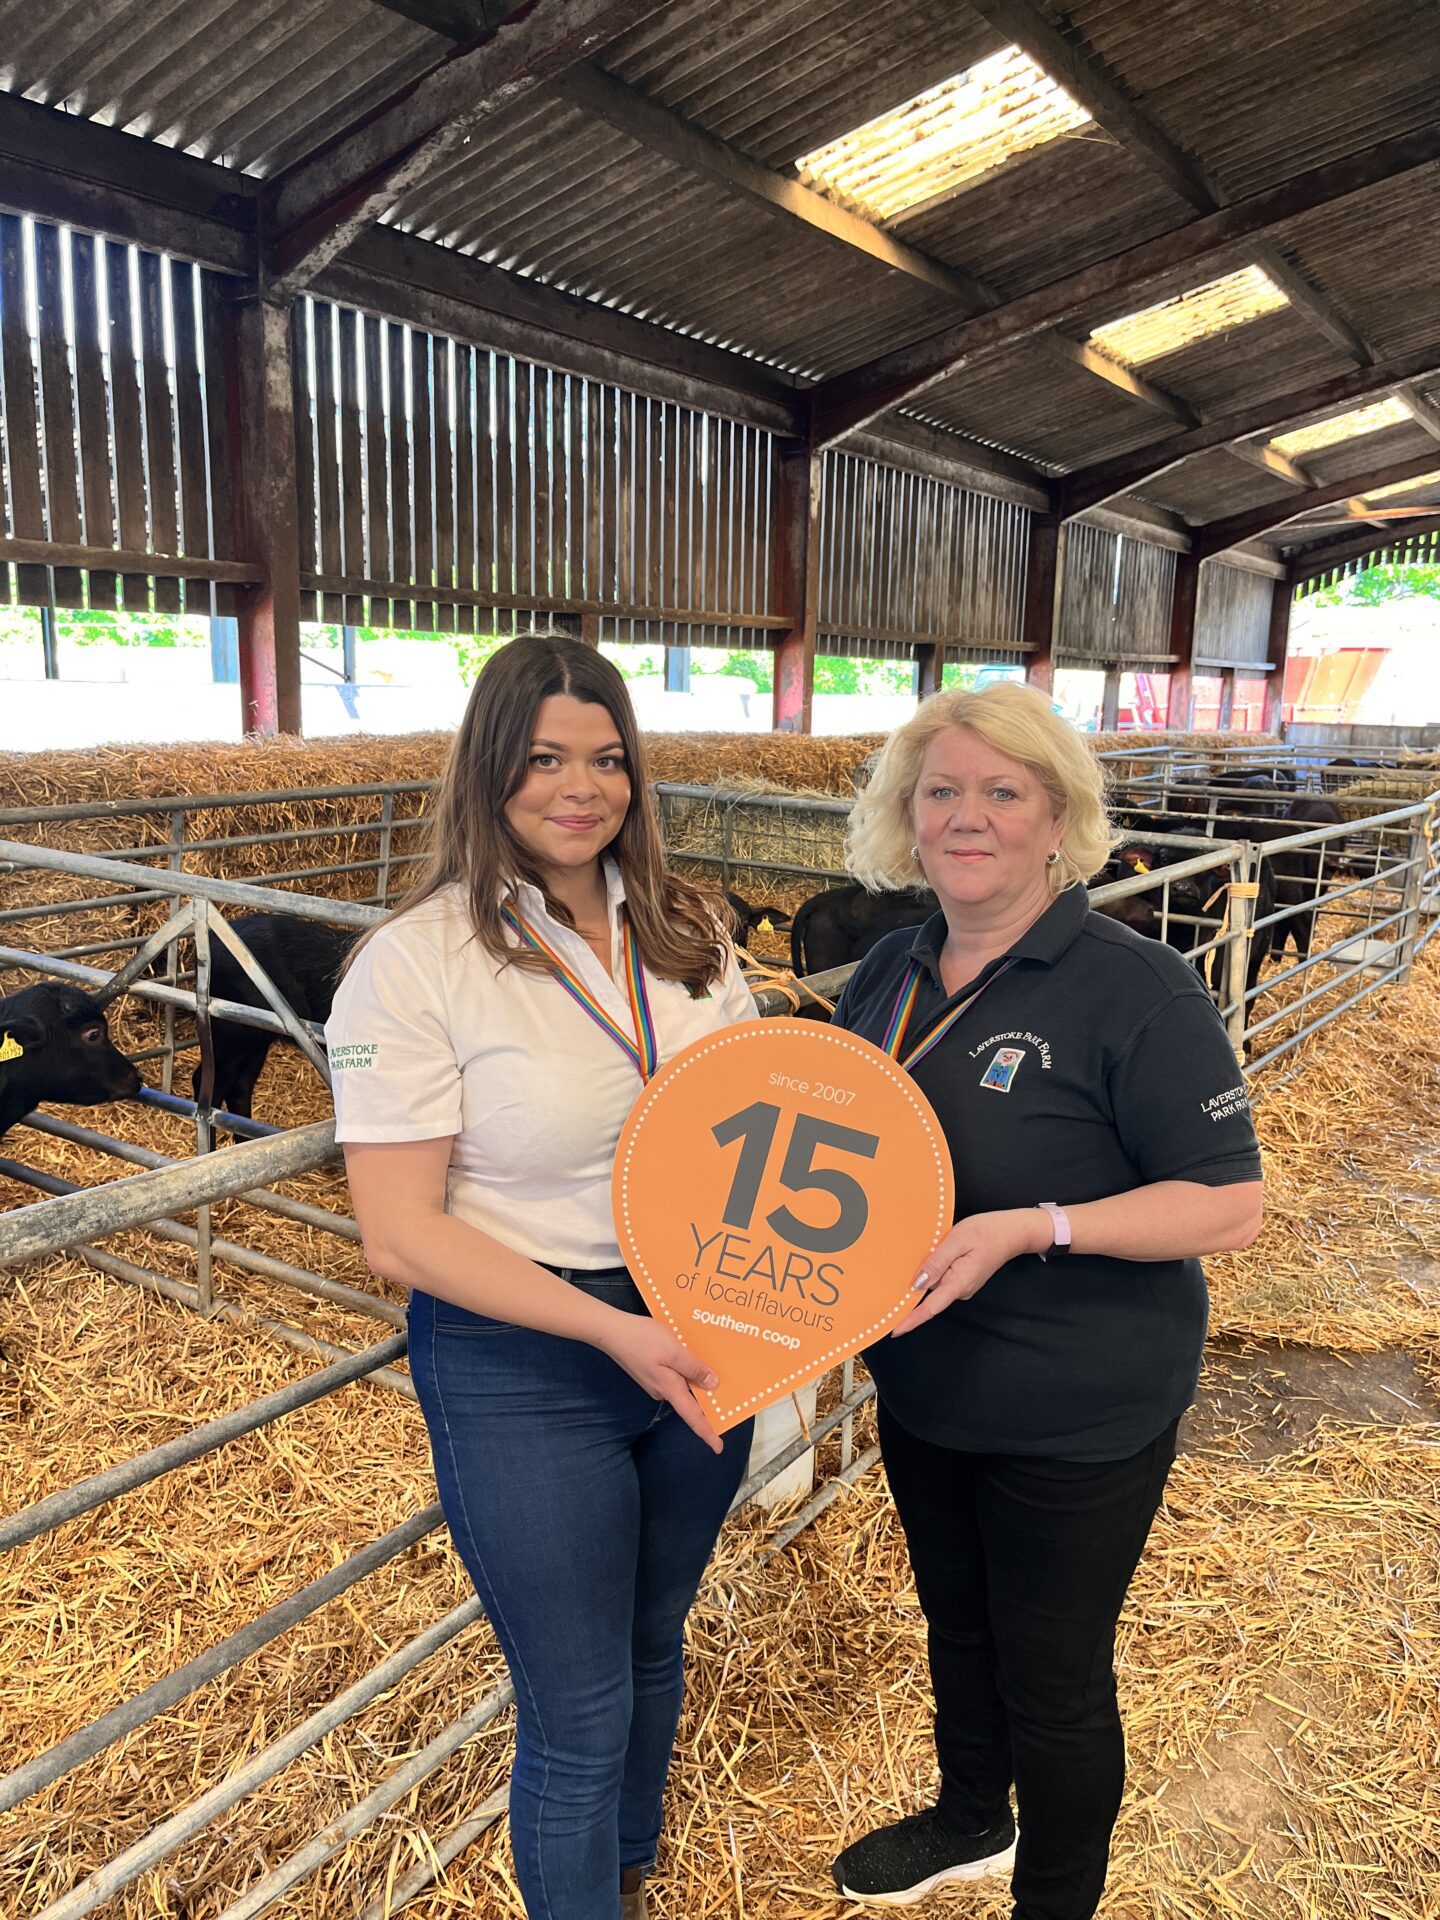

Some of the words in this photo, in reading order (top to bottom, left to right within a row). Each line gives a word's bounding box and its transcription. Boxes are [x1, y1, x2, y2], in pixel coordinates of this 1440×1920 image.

[329, 1044, 378, 1059] AVERSTOKE
[345, 1057, 372, 1068] FARM
[1037, 1041, 1052, 1069] FARM
[768, 1071, 809, 1094] since
[812, 1082, 856, 1106] 2007
[1210, 1103, 1237, 1122] PARK
[711, 1101, 880, 1254] 15
[690, 1222, 844, 1306] YEARS
[675, 1272, 701, 1291] of
[704, 1276, 754, 1309] local
[755, 1291, 835, 1332] flavours
[692, 1308, 760, 1337] southern
